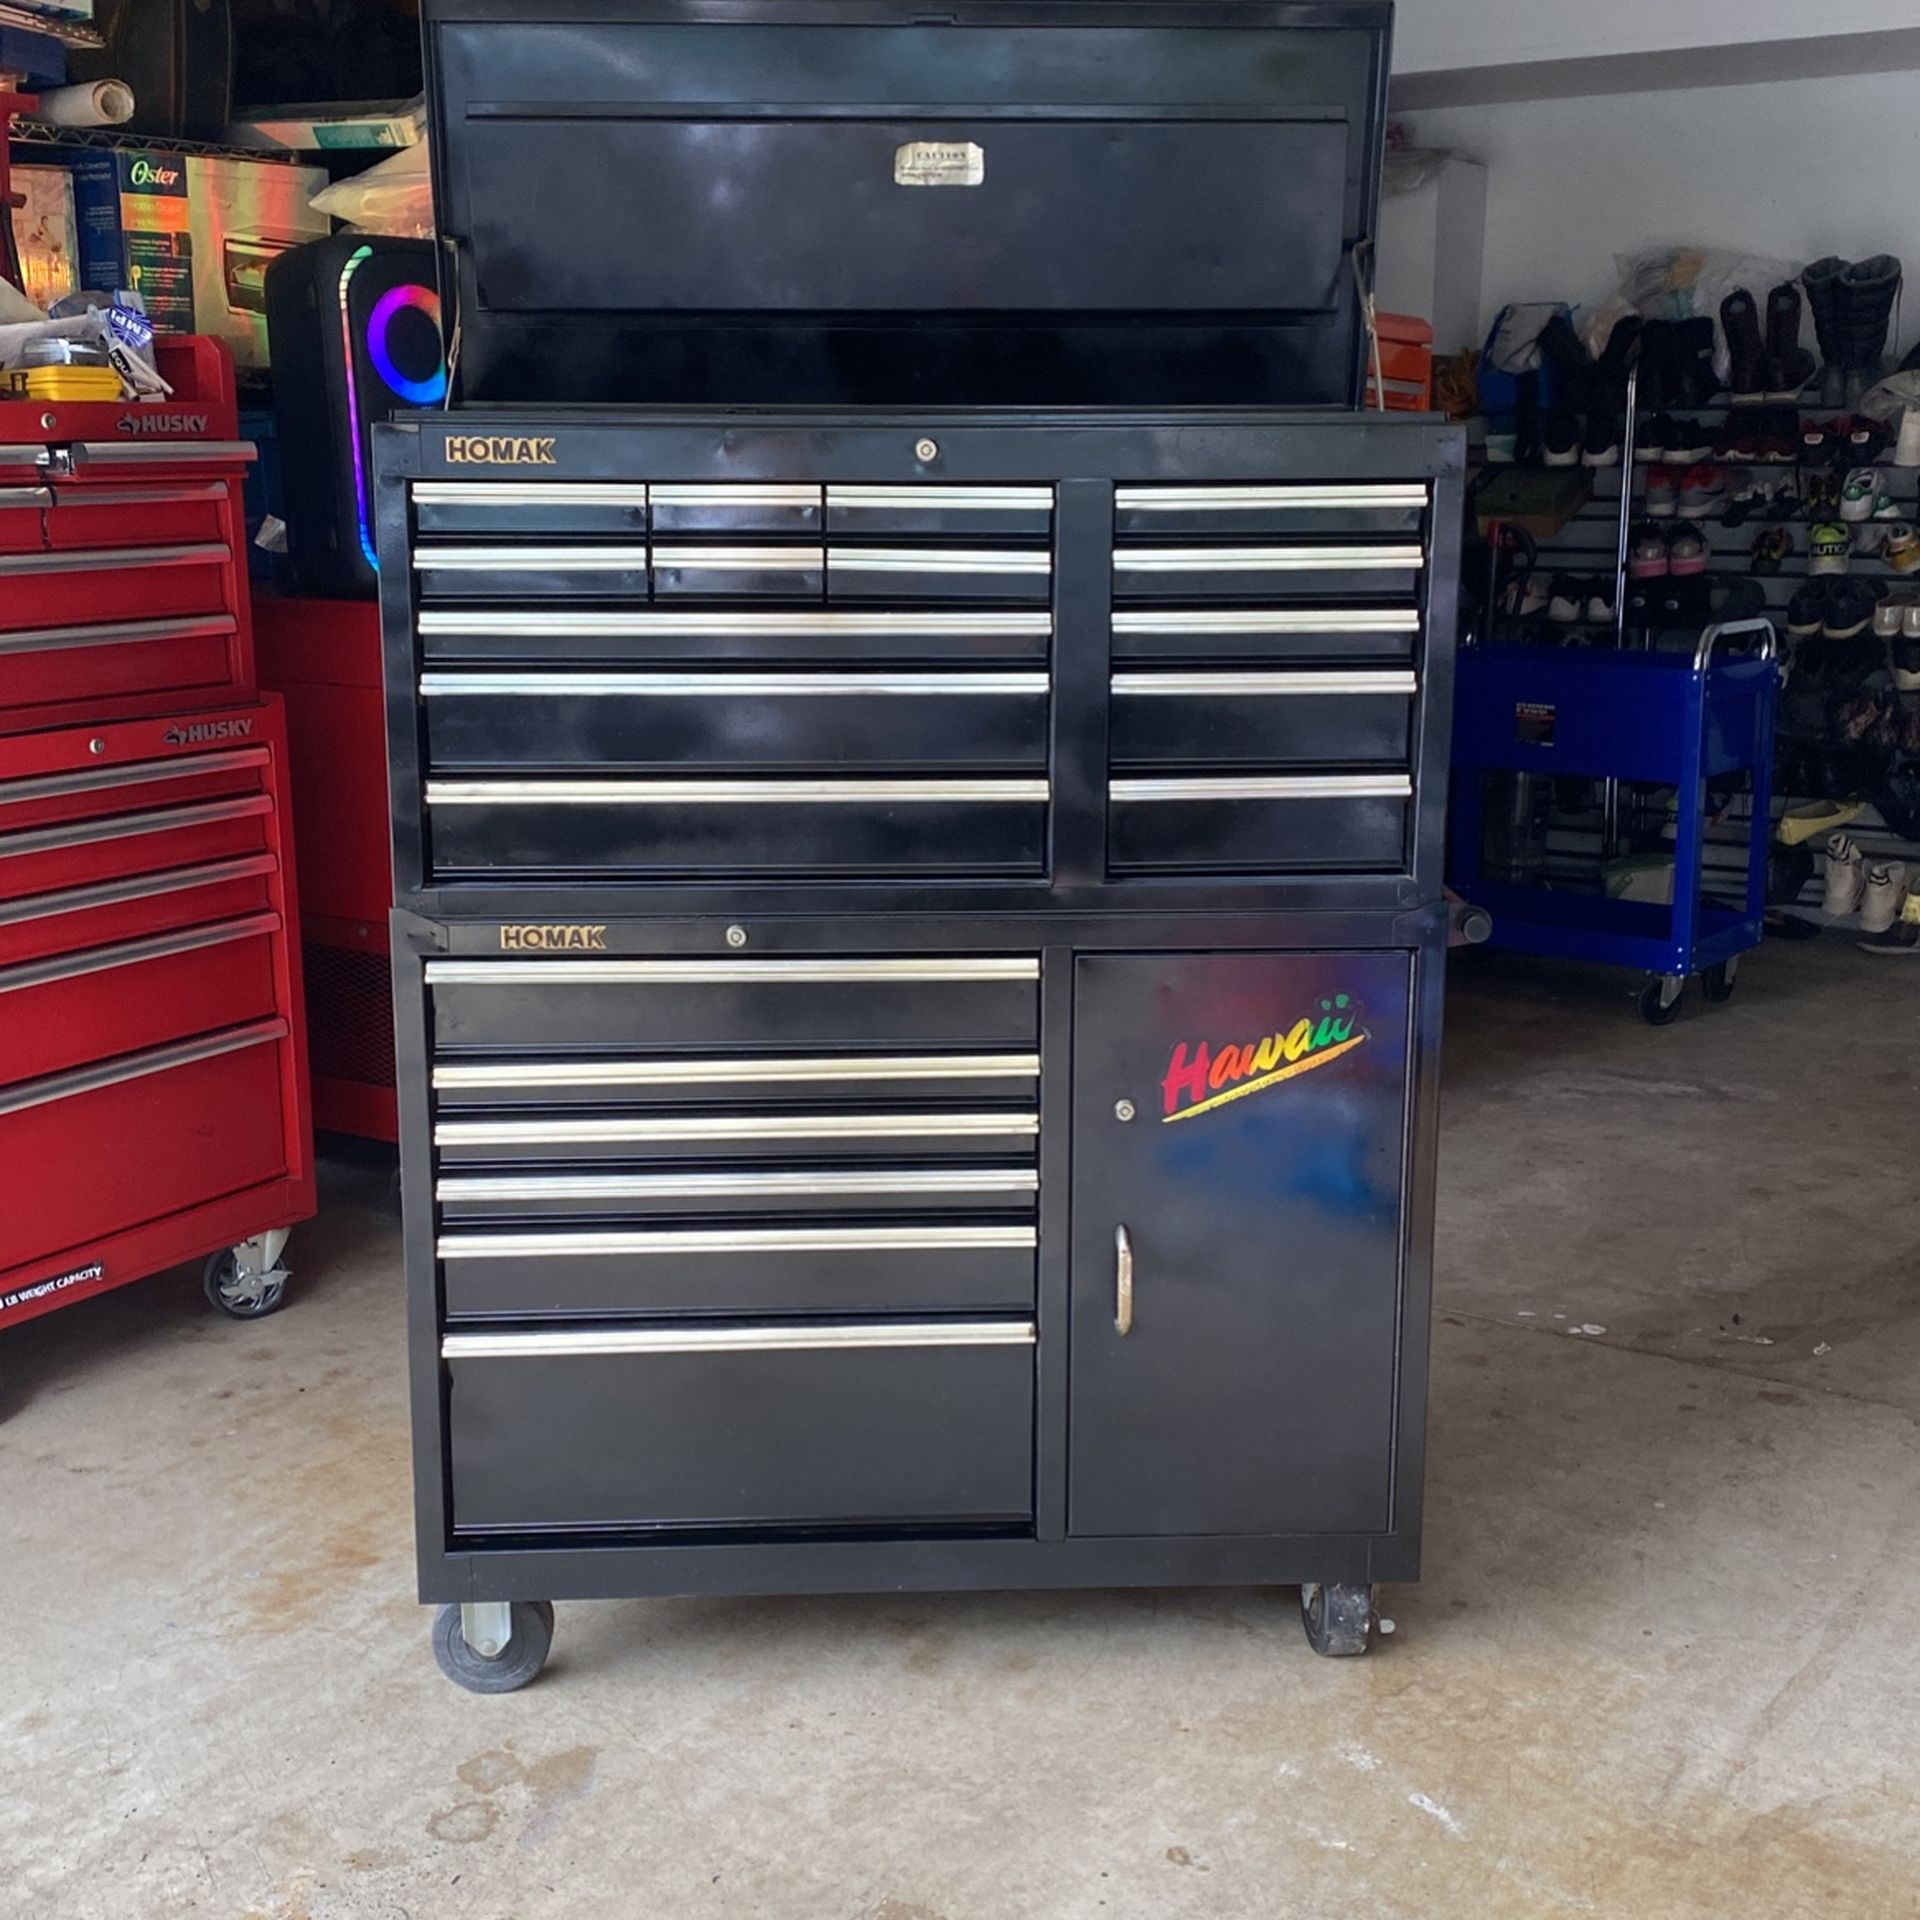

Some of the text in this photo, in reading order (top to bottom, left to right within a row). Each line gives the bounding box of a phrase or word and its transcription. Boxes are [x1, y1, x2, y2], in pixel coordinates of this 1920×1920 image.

[130, 160, 179, 186] Oster
[111, 309, 153, 341] EMPI
[141, 414, 208, 432] HUSKY
[445, 436, 557, 464] HOMAK
[188, 718, 253, 742] HUSKY
[500, 925, 607, 949] HOMAK
[1161, 994, 1358, 1114] Hawaii
[5, 1293, 19, 1307] LB
[18, 1283, 56, 1302] WEIGHT
[56, 1266, 102, 1288] CAPACITY
